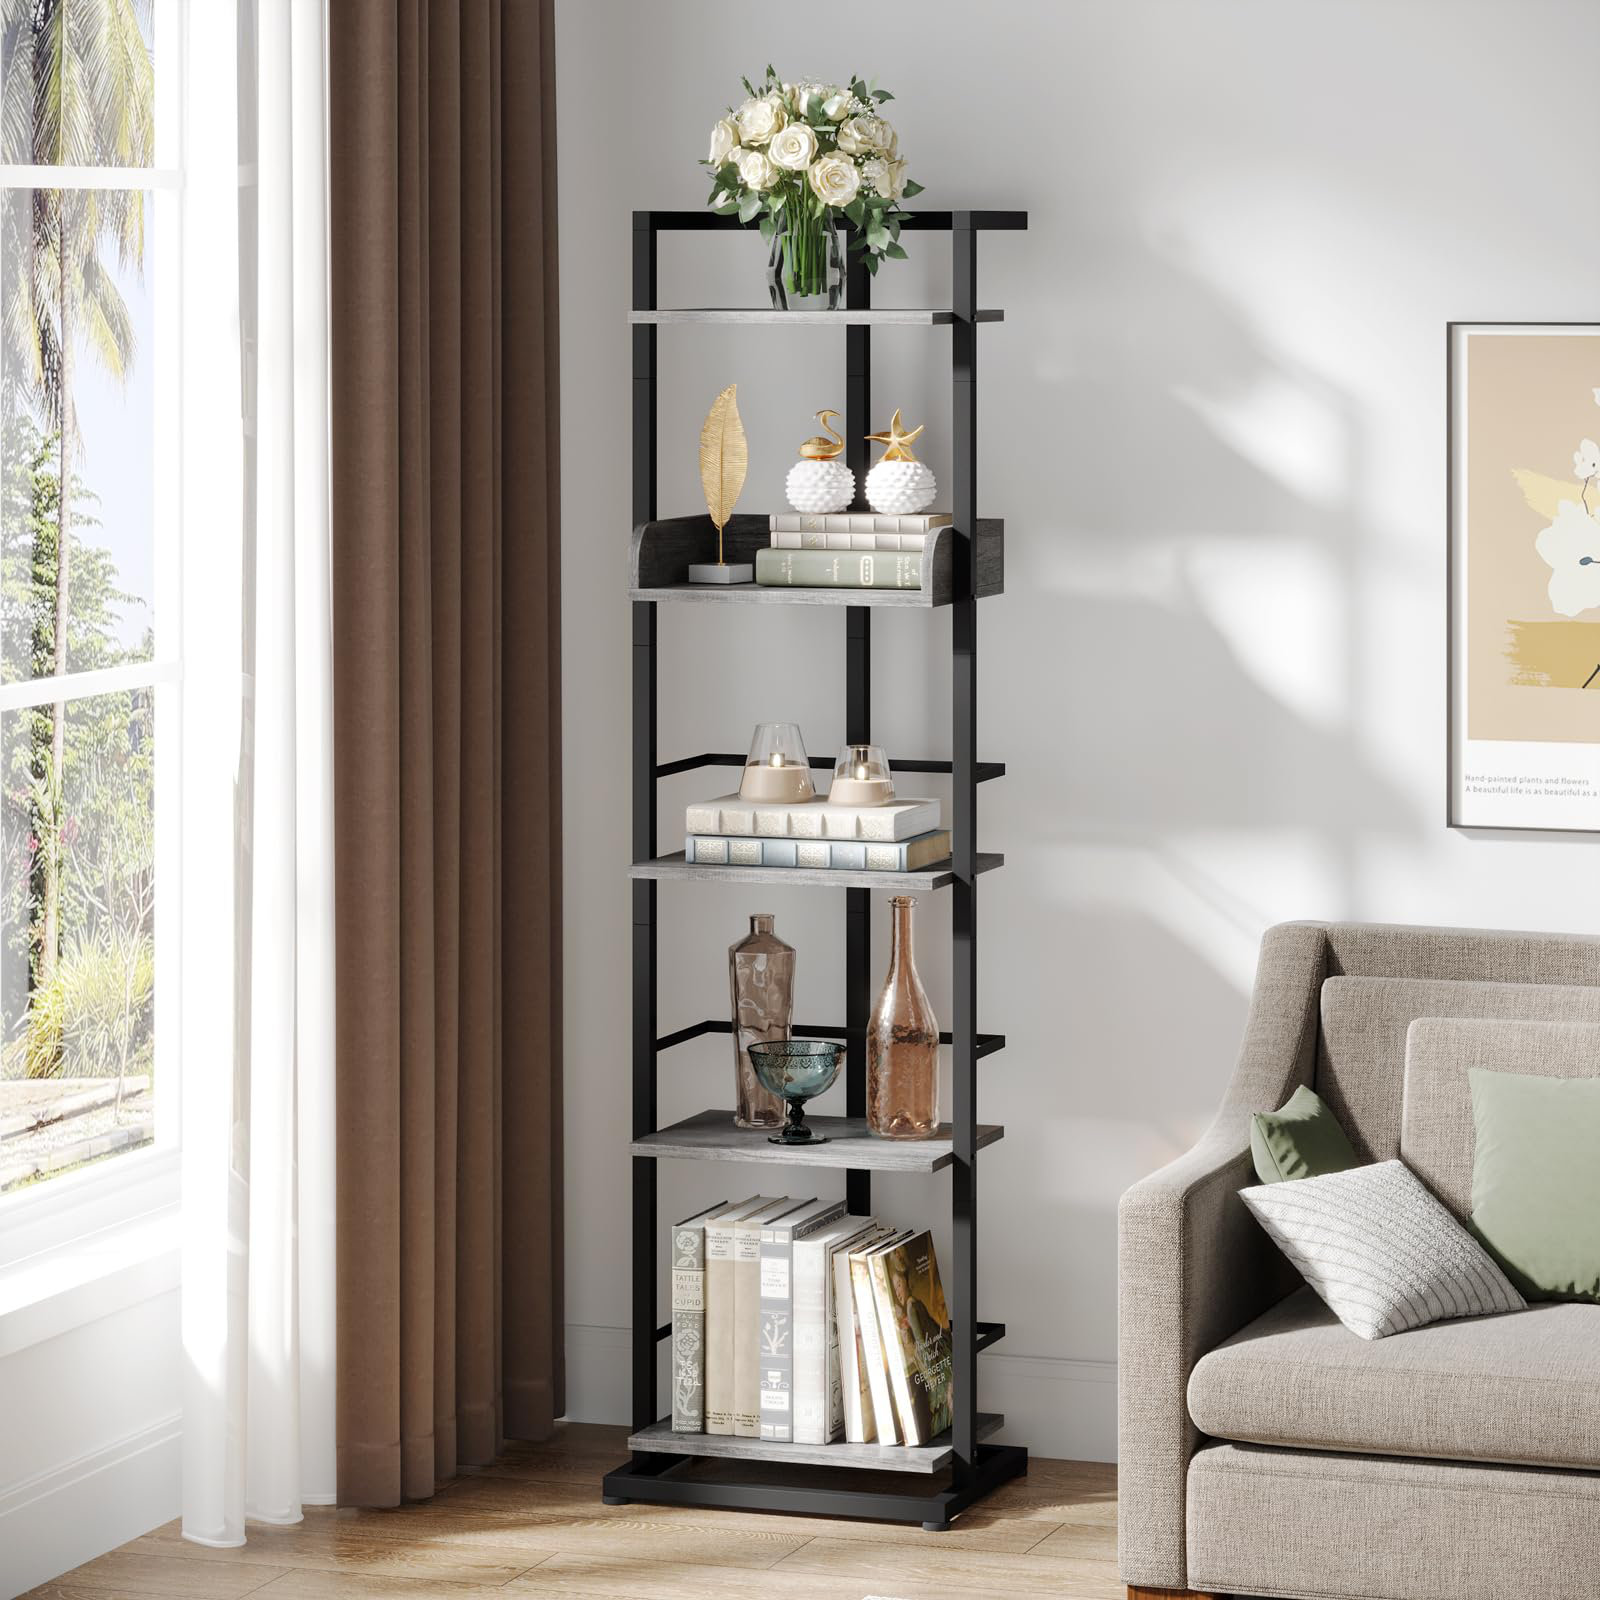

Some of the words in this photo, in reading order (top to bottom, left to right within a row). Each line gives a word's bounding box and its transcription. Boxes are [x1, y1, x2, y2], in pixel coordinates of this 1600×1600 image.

[1465, 775, 1516, 784] Hand-painted
[1519, 776, 1543, 785] plants
[1544, 777, 1559, 785] and
[1561, 777, 1589, 786] flowers
[1465, 785, 1471, 793] A
[1473, 785, 1509, 794] beautiful
[1510, 786, 1524, 794] life
[1525, 787, 1532, 795] is
[1544, 787, 1580, 797] beautiful
[1582, 789, 1591, 797] as
[676, 1274, 701, 1282] TATTLE
[676, 1284, 701, 1292] TALES
[914, 1355, 952, 1385] GEORGETTE
[924, 1372, 946, 1392] HEYER
